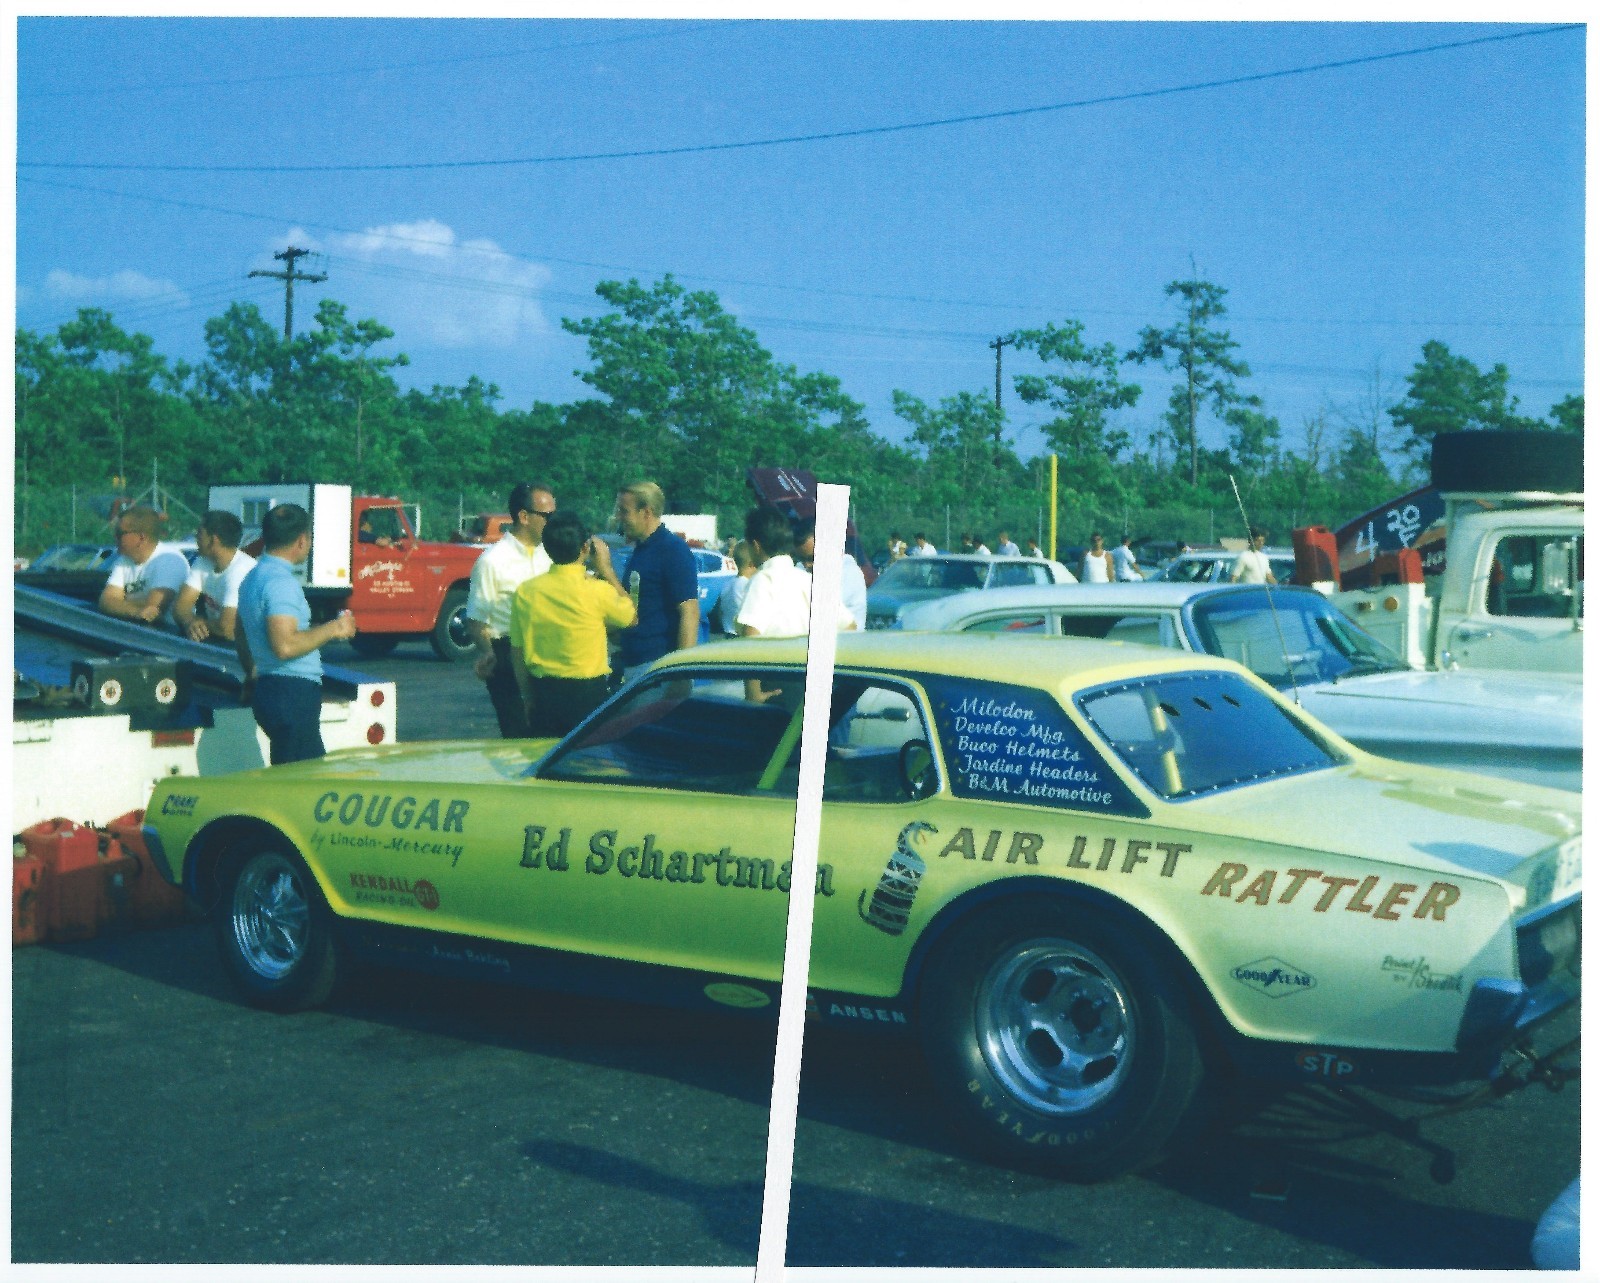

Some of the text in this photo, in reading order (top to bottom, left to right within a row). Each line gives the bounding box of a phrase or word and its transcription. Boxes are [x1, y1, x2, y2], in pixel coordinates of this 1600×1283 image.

[1355, 520, 1379, 563] 4
[951, 697, 1037, 721] Milodon
[955, 717, 1017, 737] Develco
[958, 735, 1083, 762] Buco Helmets
[958, 754, 1100, 783] Jardine Headers
[968, 773, 1112, 806] B&M Automotive
[314, 791, 470, 833] COUGAR
[519, 824, 572, 872] Ed
[938, 827, 1193, 878] AIR LIFT
[350, 872, 415, 894] KENDALL
[1200, 861, 1461, 922] RATTLER
[1235, 967, 1311, 988] GOODYEAR
[1302, 1052, 1355, 1077] STP
